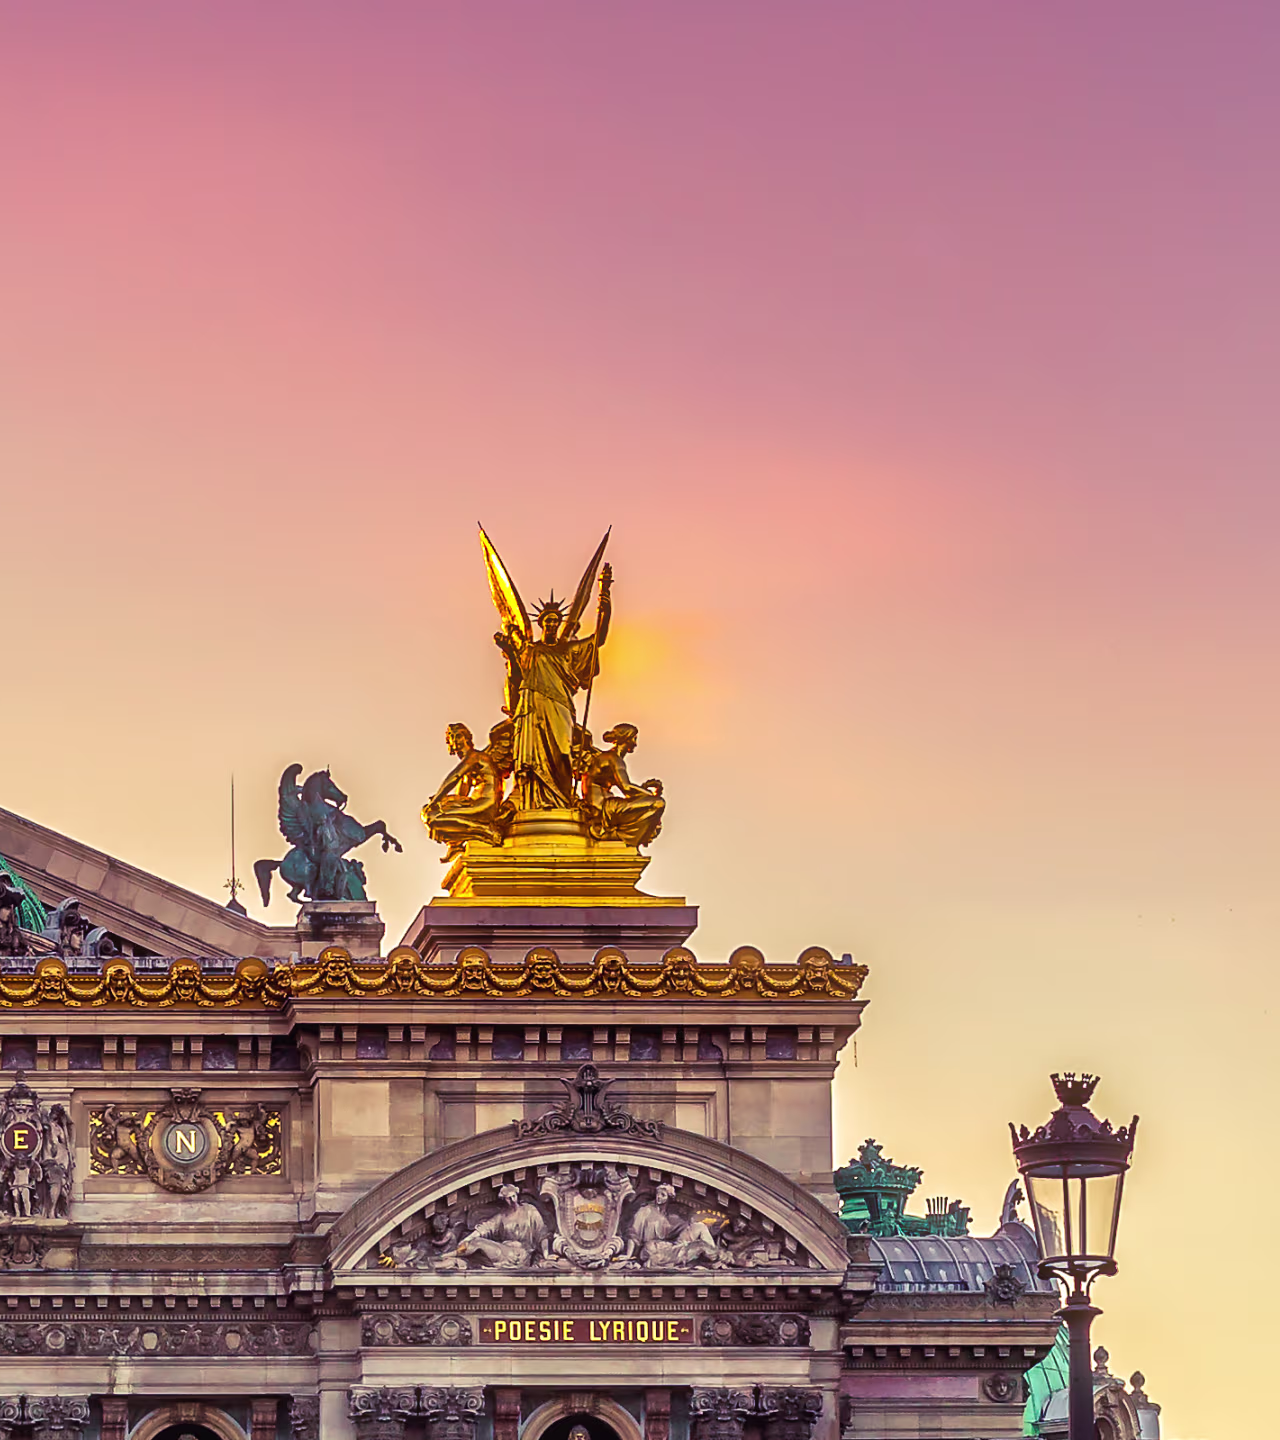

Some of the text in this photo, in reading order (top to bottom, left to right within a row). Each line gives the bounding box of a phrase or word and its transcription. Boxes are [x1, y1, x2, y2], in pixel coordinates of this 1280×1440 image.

[13, 1129, 29, 1150] E
[175, 1130, 197, 1154] N
[494, 1320, 680, 1342] POESIE LYRIQUE
